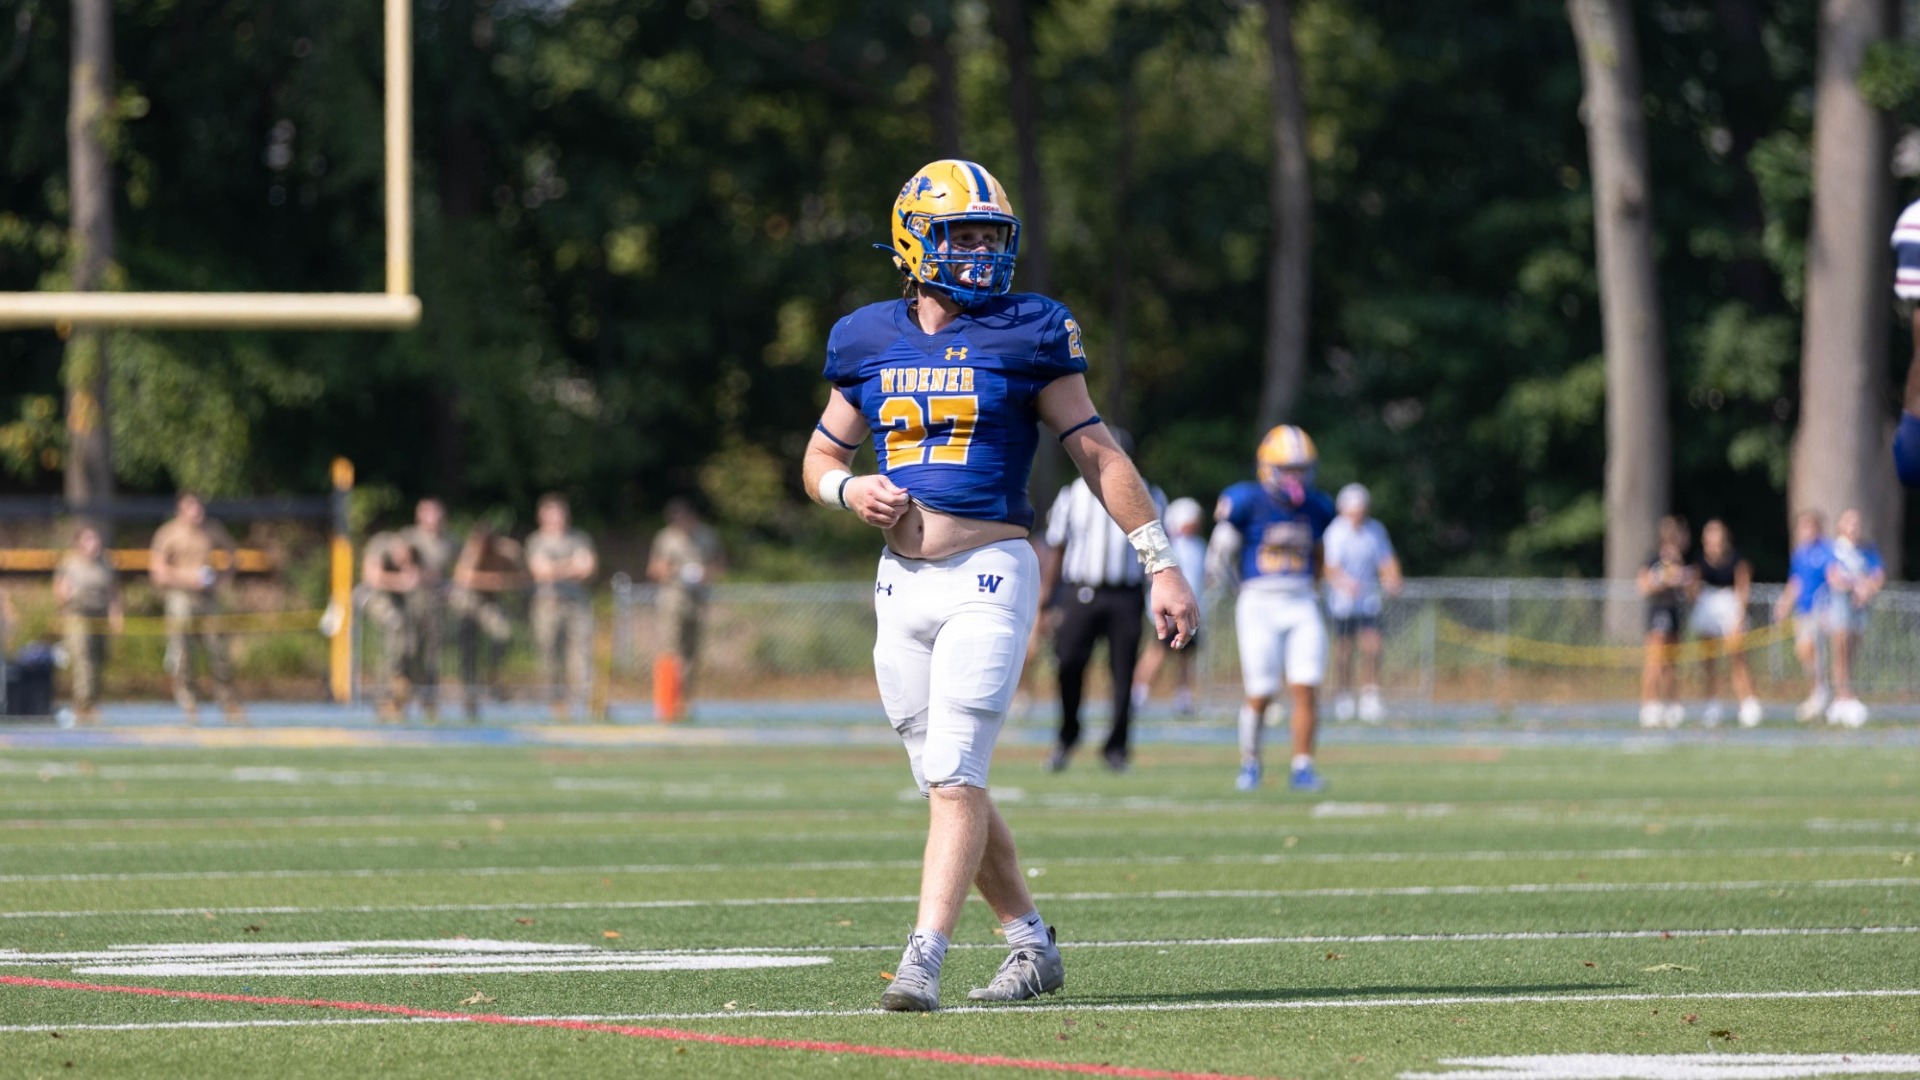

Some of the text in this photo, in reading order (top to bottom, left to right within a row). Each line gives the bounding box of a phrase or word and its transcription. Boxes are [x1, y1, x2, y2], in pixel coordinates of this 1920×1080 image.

[880, 367, 975, 393] WIDENER
[879, 395, 979, 471] 27
[977, 574, 1004, 594] W
